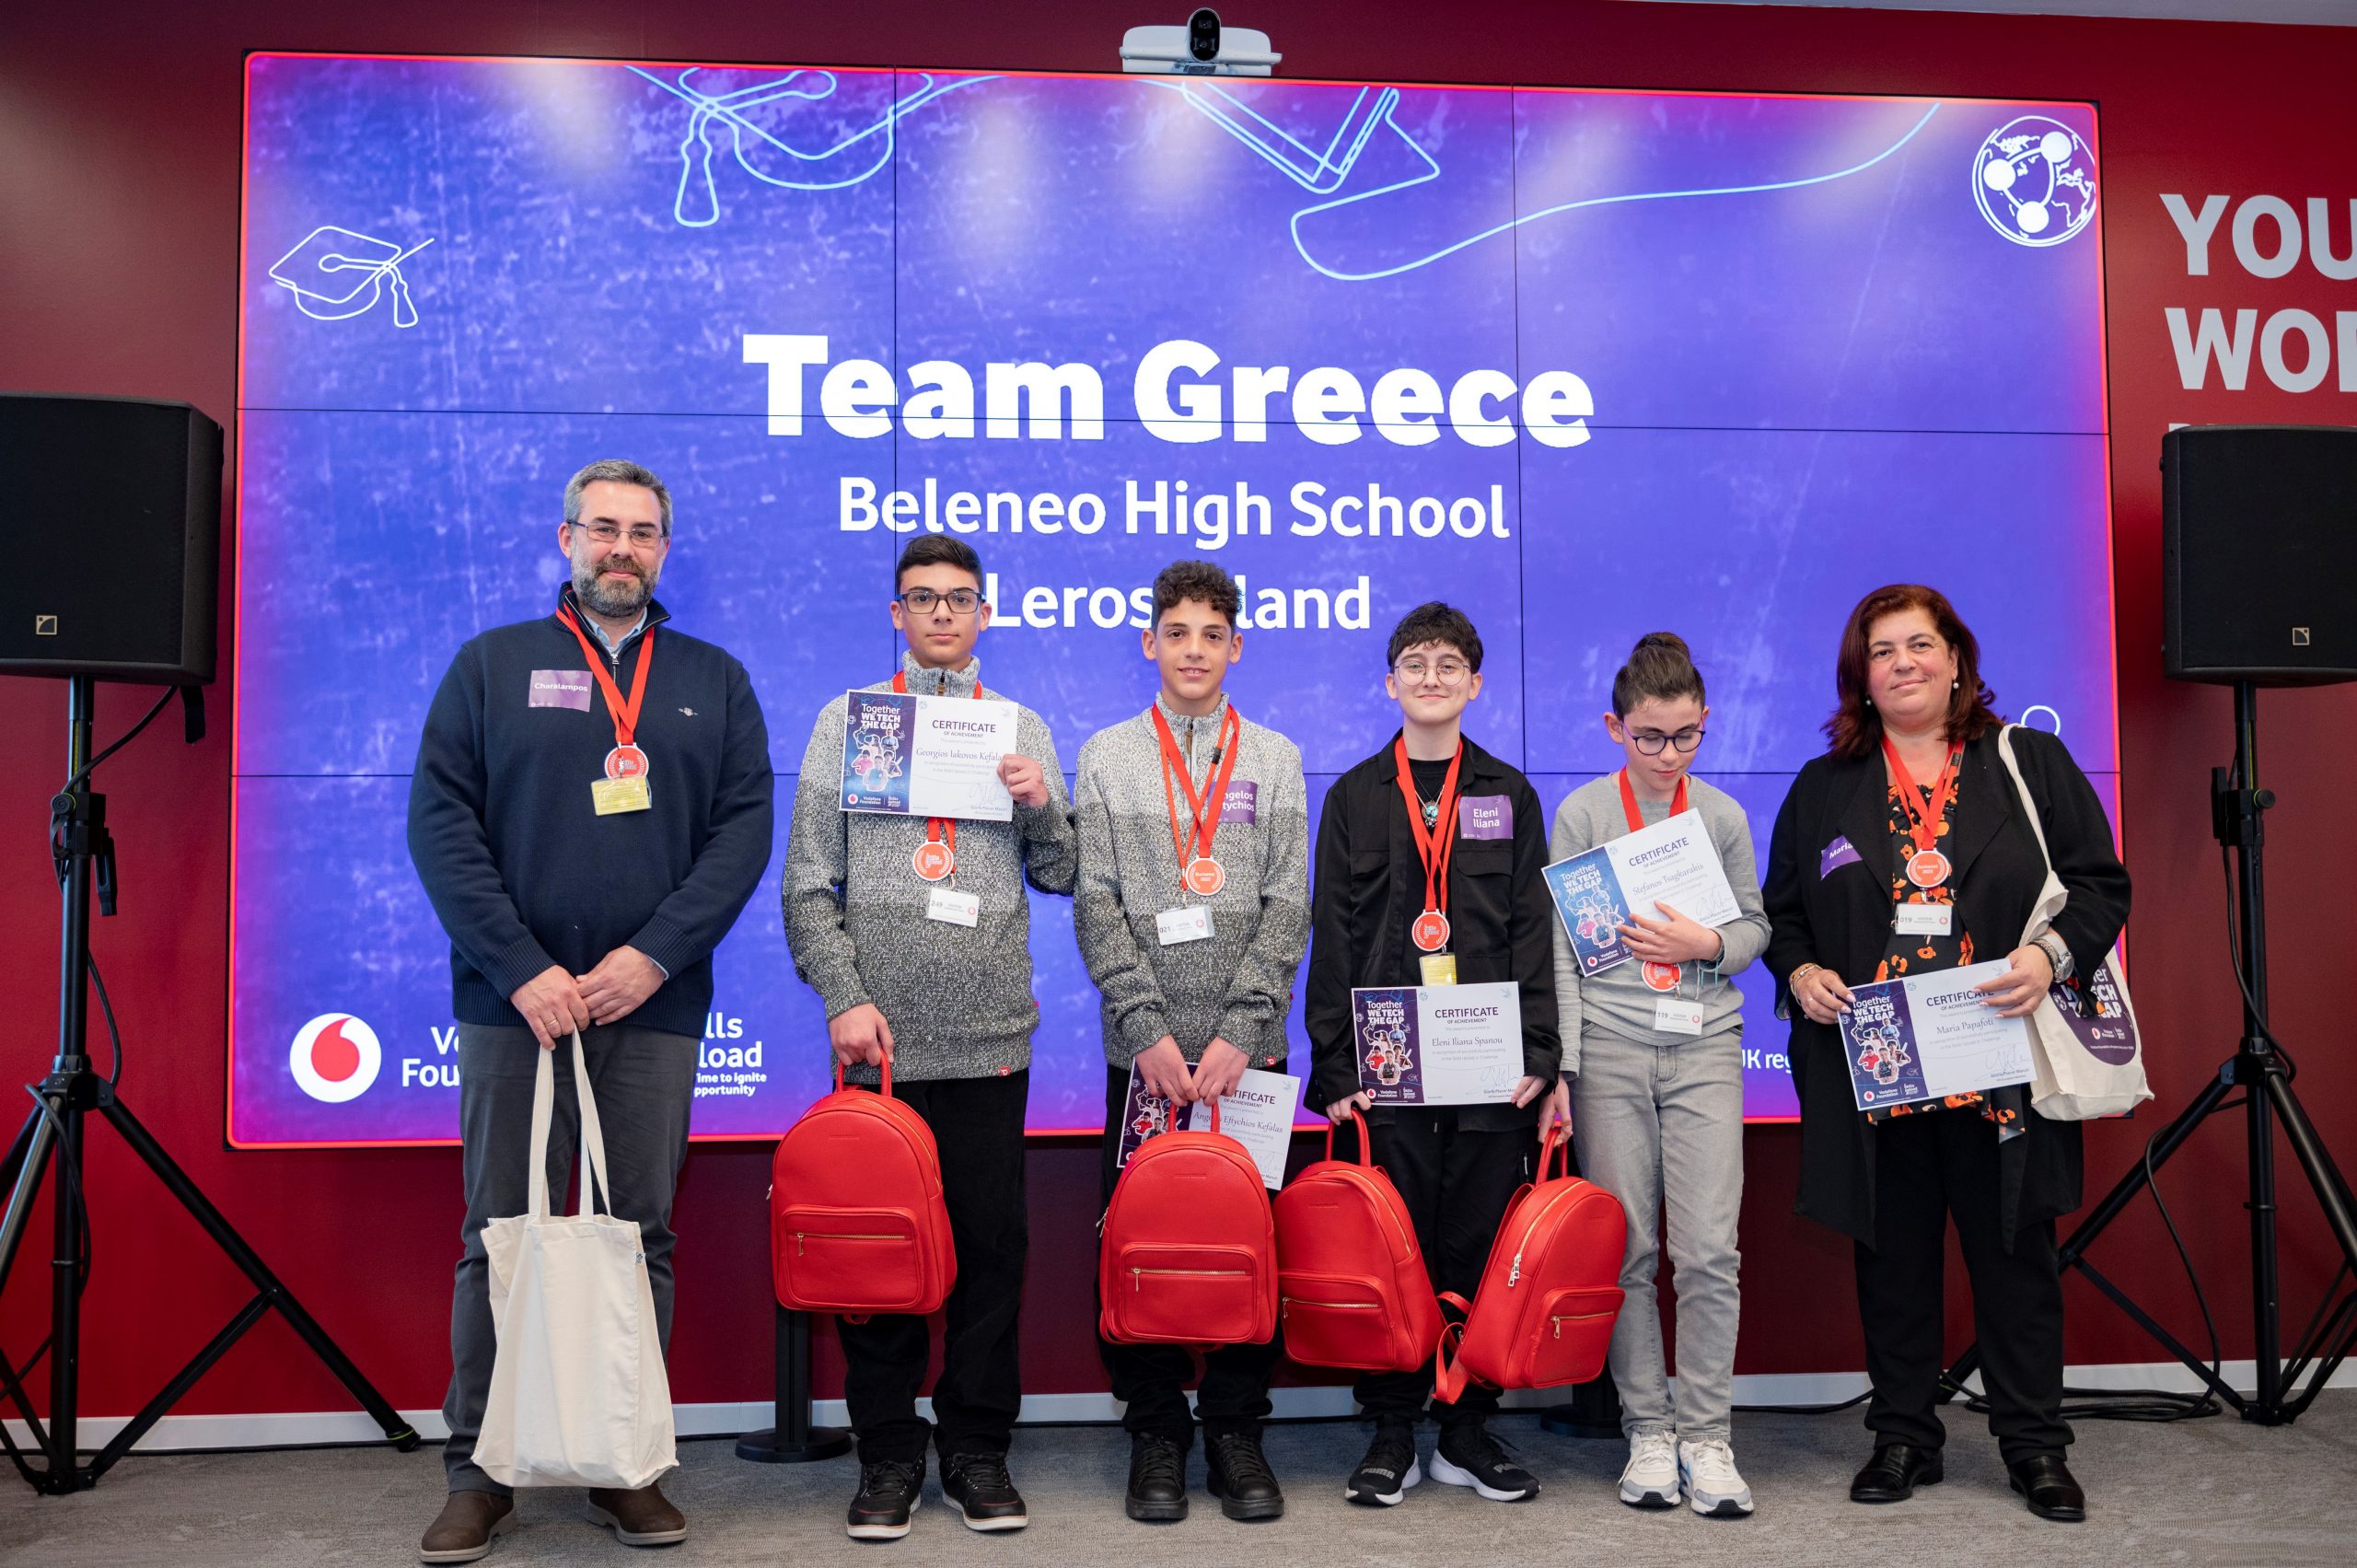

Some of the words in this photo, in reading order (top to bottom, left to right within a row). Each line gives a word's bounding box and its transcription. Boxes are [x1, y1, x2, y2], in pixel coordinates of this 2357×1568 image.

[742, 334, 1105, 440] Team
[1134, 340, 1595, 447] Greece
[839, 476, 1107, 535] Beleneo
[1125, 481, 1271, 550] High
[1290, 482, 1509, 539] School
[985, 573, 1154, 630] Leros
[1237, 575, 1371, 630] land
[534, 682, 588, 691] Charalampos
[861, 703, 901, 714] Together
[861, 713, 876, 721] WE
[877, 714, 901, 723] TECH
[861, 720, 879, 729] THE
[880, 722, 900, 730] GAP
[932, 719, 996, 733] CERTIFICATE
[916, 747, 948, 760] Georgios
[979, 750, 1003, 762] Kefala
[1225, 791, 1253, 801] ngelos
[1223, 800, 1254, 811] tychios
[1473, 807, 1498, 818] Eleni
[1473, 819, 1500, 828] Iliana
[1629, 837, 1689, 866] CERTIFICATE
[1829, 842, 1853, 859] Maria
[1561, 864, 1596, 881] Together
[1563, 879, 1578, 889] WE
[1577, 869, 1601, 883] TECH
[1366, 1000, 1402, 1010] Together
[1852, 995, 1890, 1008] Together
[1434, 1006, 1499, 1018] CERTIFICATE
[1852, 1007, 1869, 1016] WE
[1868, 1003, 1894, 1014] TECH
[1368, 1016, 1386, 1025] THE
[1386, 1016, 1405, 1025] GAP
[1854, 1015, 1875, 1024] THE
[1875, 1011, 1895, 1021] GAP
[1936, 1024, 1960, 1034] Maria
[1432, 1037, 1450, 1047] Eleni
[1452, 1037, 1473, 1046] Iliana
[1474, 1036, 1503, 1047] Spanou
[699, 1040, 762, 1068] load
[697, 1073, 718, 1083] ime
[720, 1073, 732, 1083] to
[694, 1084, 756, 1098] pportunity
[1234, 1090, 1276, 1105] TIFICATE
[1230, 1098, 1262, 1108] ACHIEVEMENT
[1224, 1115, 1255, 1128] Eftychios
[1258, 1121, 1283, 1133] Kefalas
